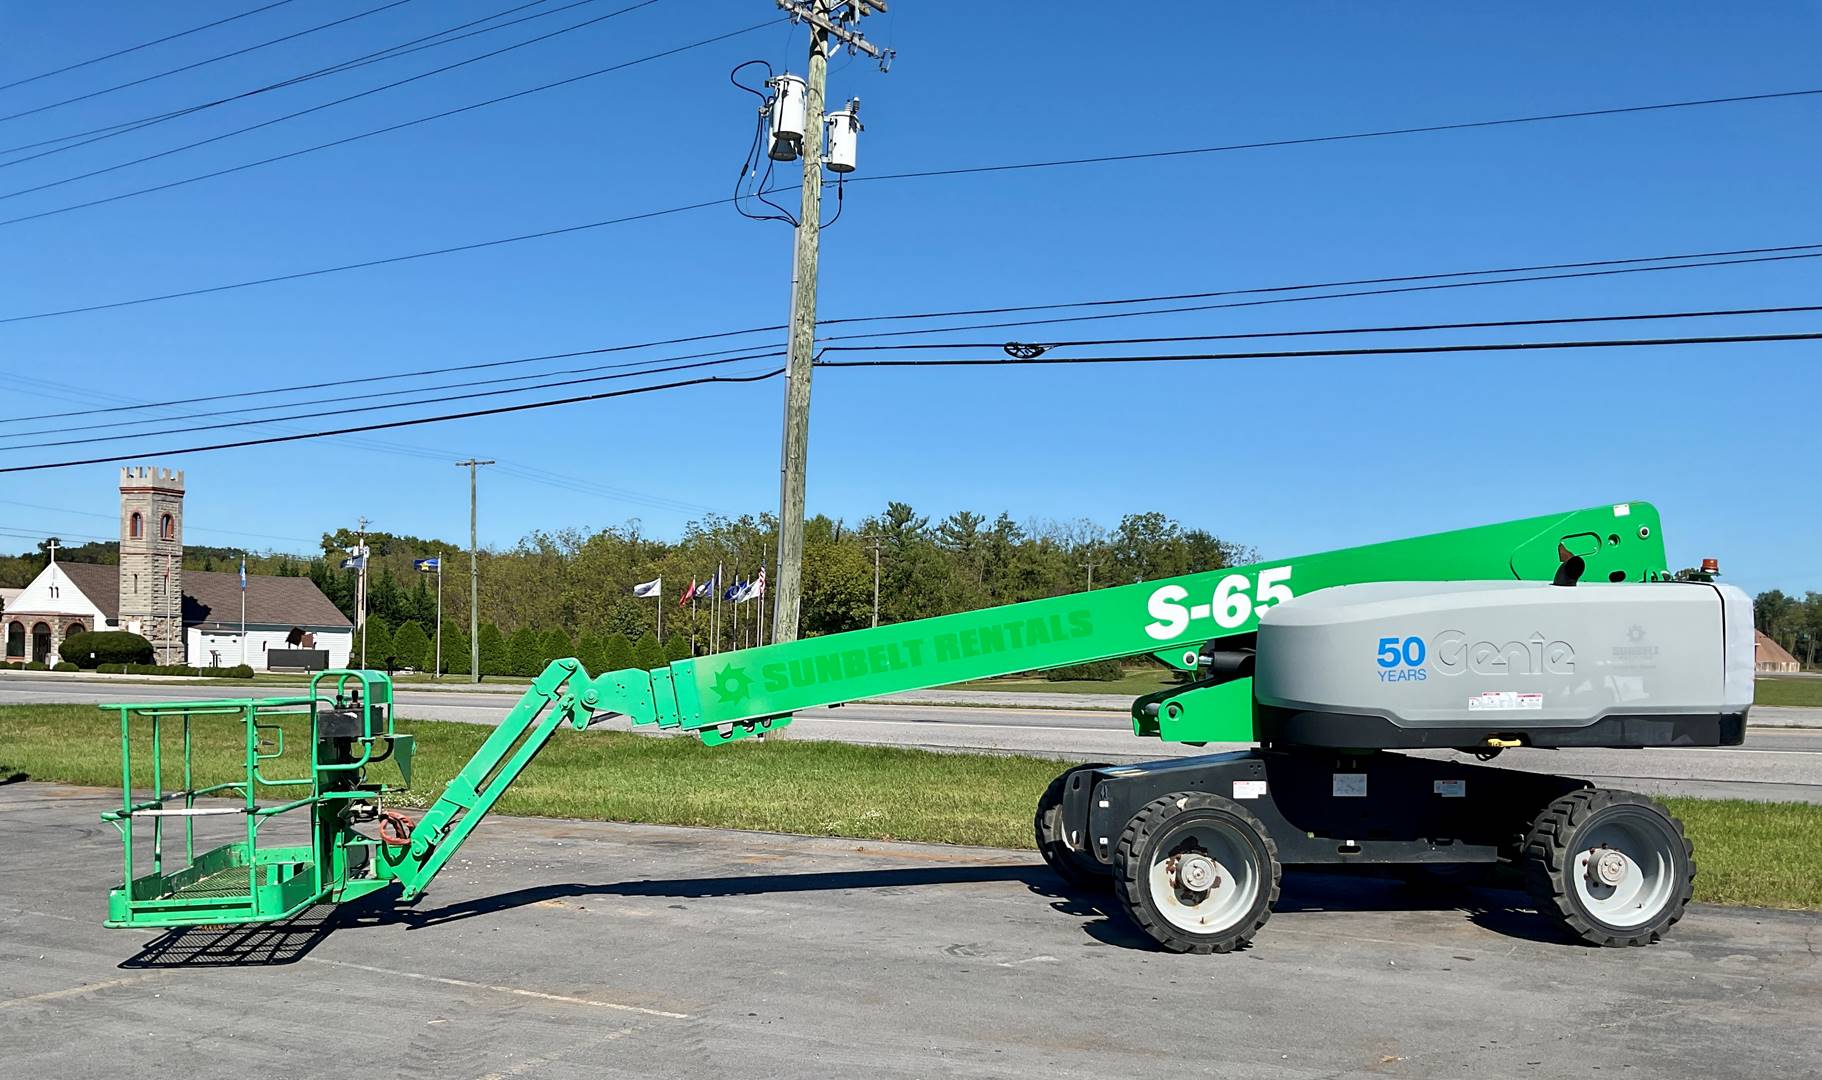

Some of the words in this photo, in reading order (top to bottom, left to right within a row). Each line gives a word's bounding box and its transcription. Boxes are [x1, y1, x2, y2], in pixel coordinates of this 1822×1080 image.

[1144, 565, 1294, 640] S-65
[762, 638, 925, 693] SUNBELT
[934, 609, 1093, 664] RENTALS
[1377, 636, 1426, 668] 50
[1431, 629, 1576, 677] Genie
[1377, 669, 1427, 682] YEARS
